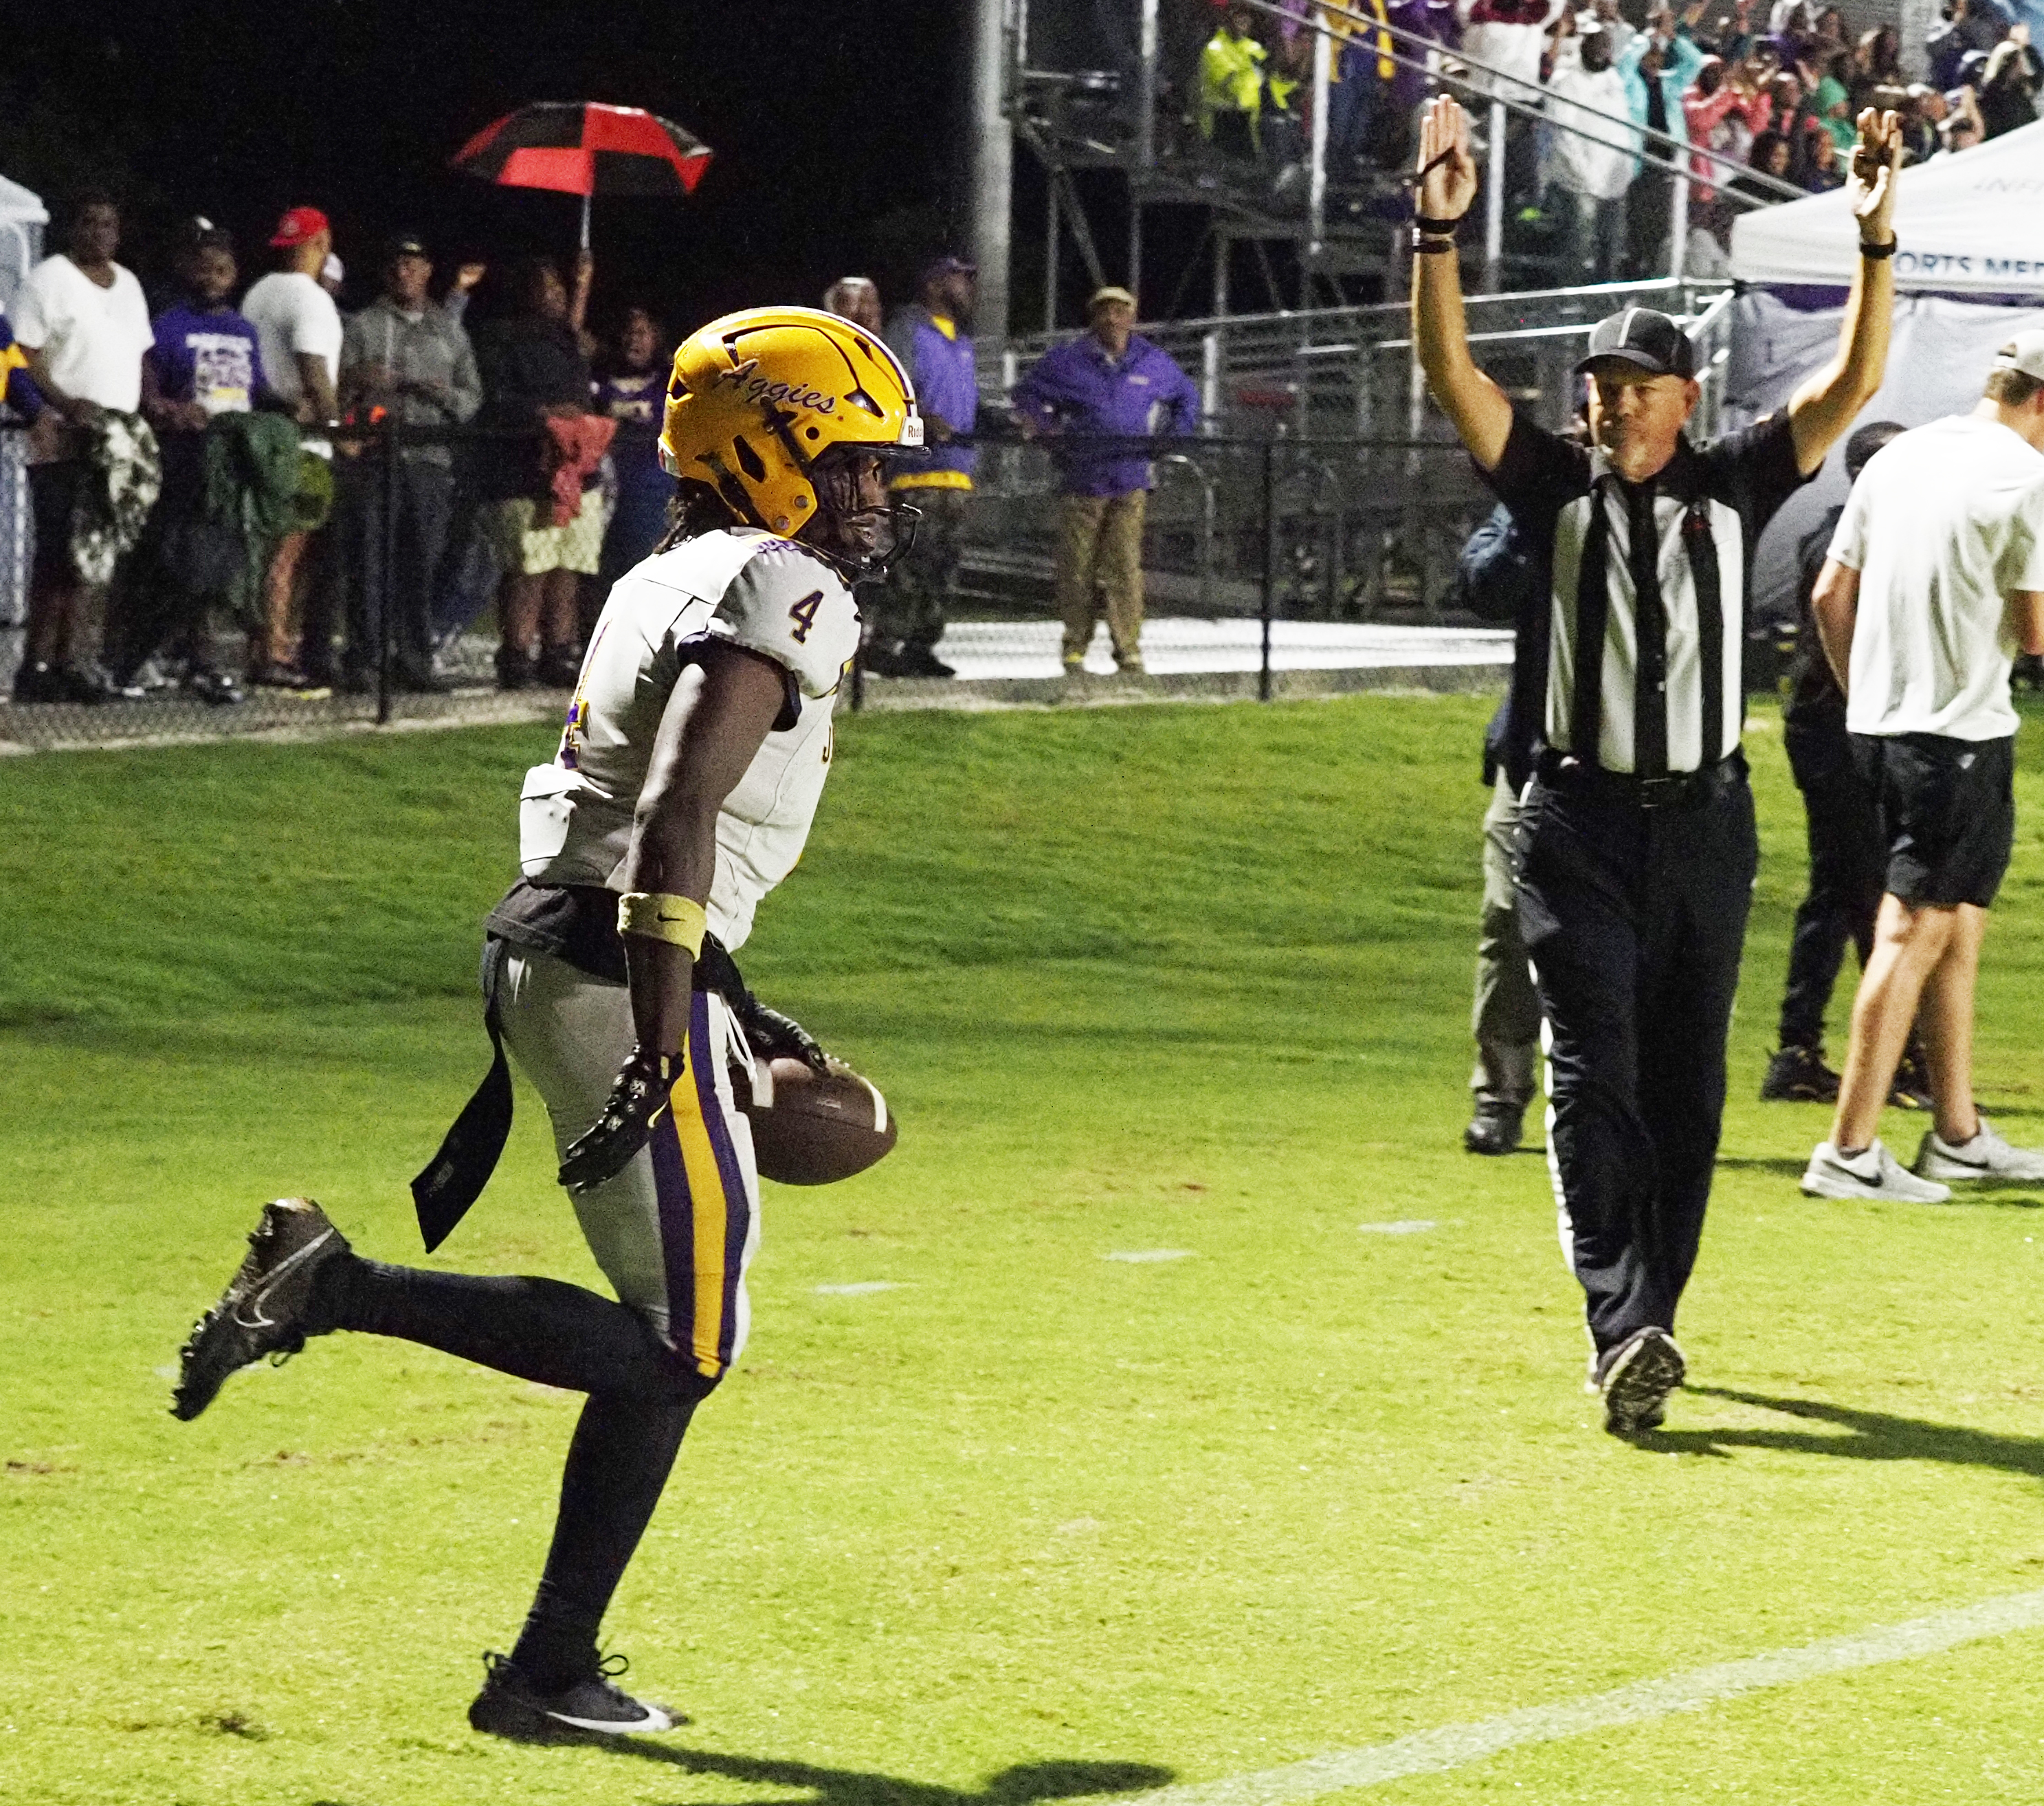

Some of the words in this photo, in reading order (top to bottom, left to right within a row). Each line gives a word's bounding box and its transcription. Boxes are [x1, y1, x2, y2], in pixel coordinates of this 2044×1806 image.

[1896, 252, 1971, 274] ORTS
[712, 358, 836, 415] Aggies
[788, 588, 824, 646] 4
